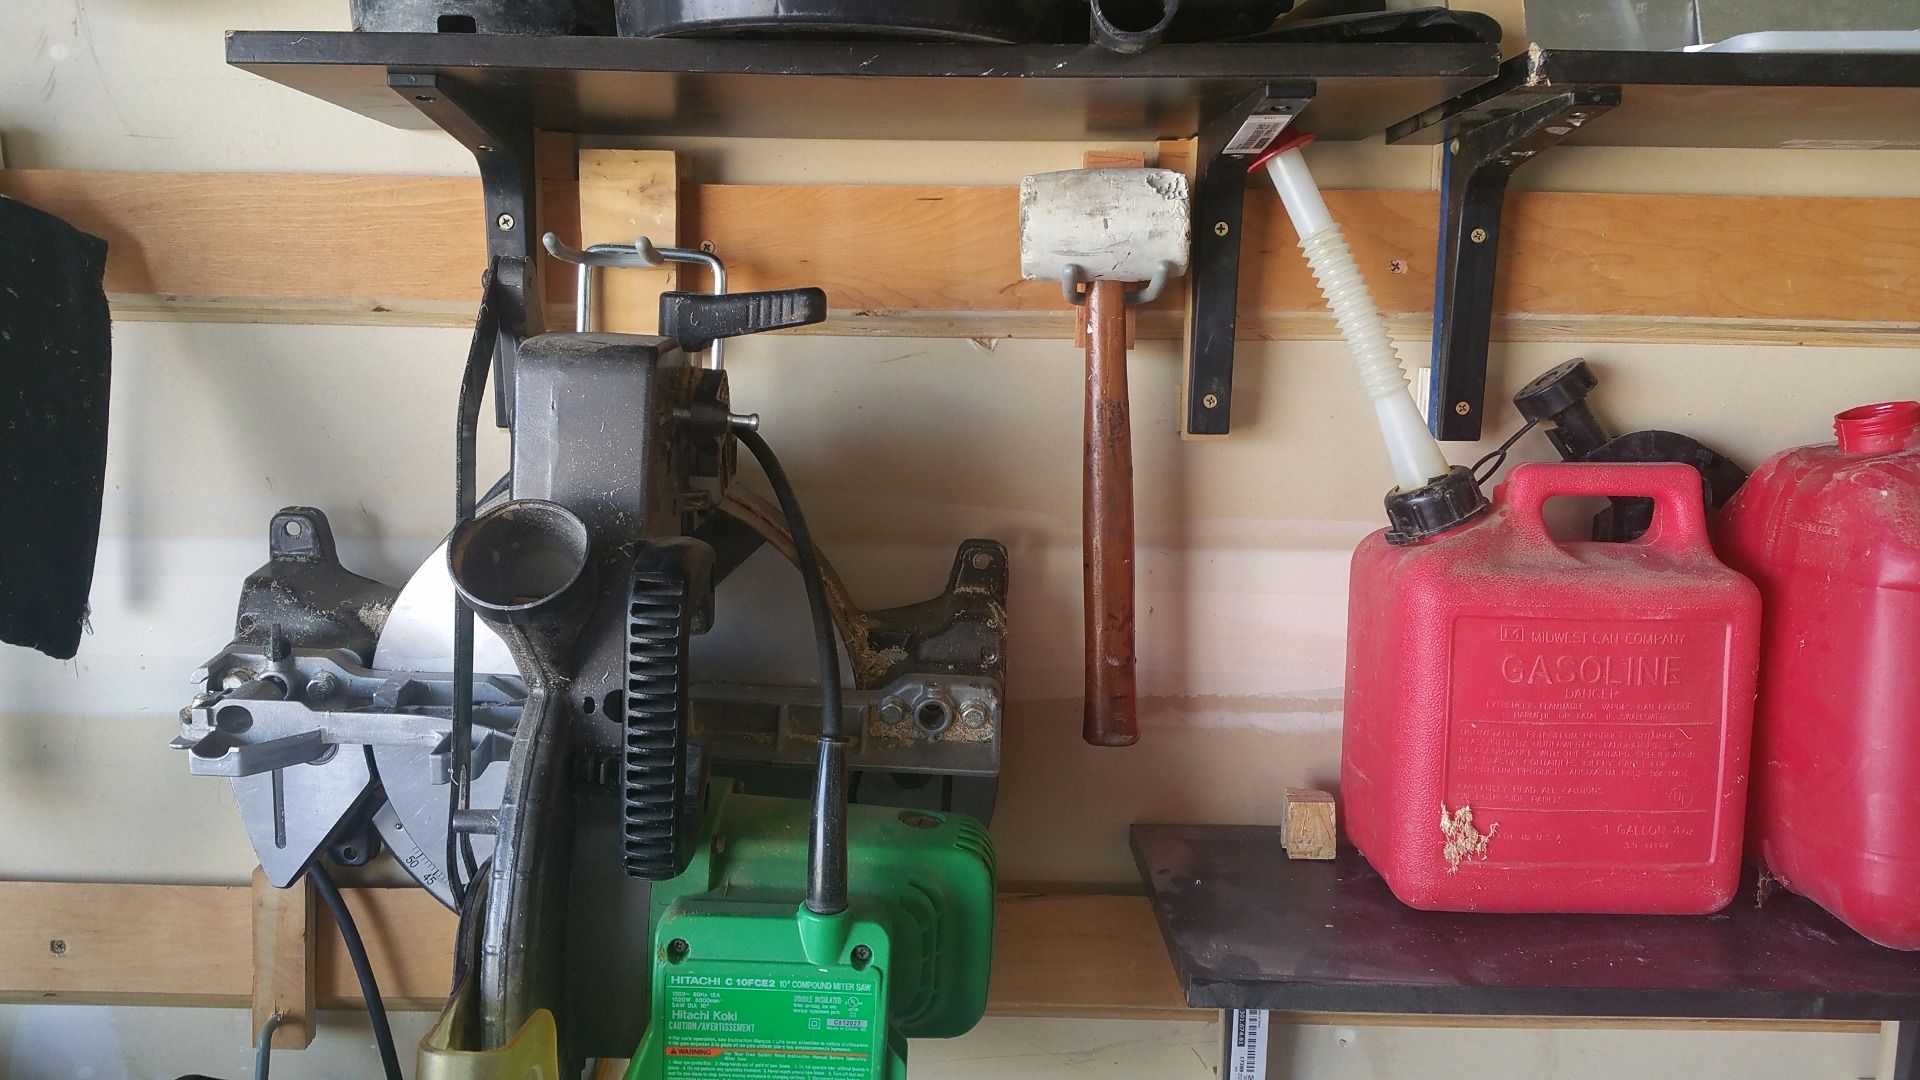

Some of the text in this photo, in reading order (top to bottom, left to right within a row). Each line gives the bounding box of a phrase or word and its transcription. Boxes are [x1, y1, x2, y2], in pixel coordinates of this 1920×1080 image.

[1531, 631, 1686, 645] MIDWEST CAN COMPANY
[1501, 654, 1682, 686] GASOLINE
[406, 856, 437, 885] 50 45
[671, 976, 720, 985] HITACHI
[725, 978, 733, 986] C
[736, 978, 776, 987] 10FCE2
[792, 981, 832, 990] COMPOUND
[834, 982, 854, 991] MITER
[856, 983, 871, 992] SAW
[672, 1010, 737, 1021] Hitachi Koki
[669, 1022, 755, 1032] CAUTION/AVERTISSEMENT
[678, 1048, 711, 1056] WARNING
